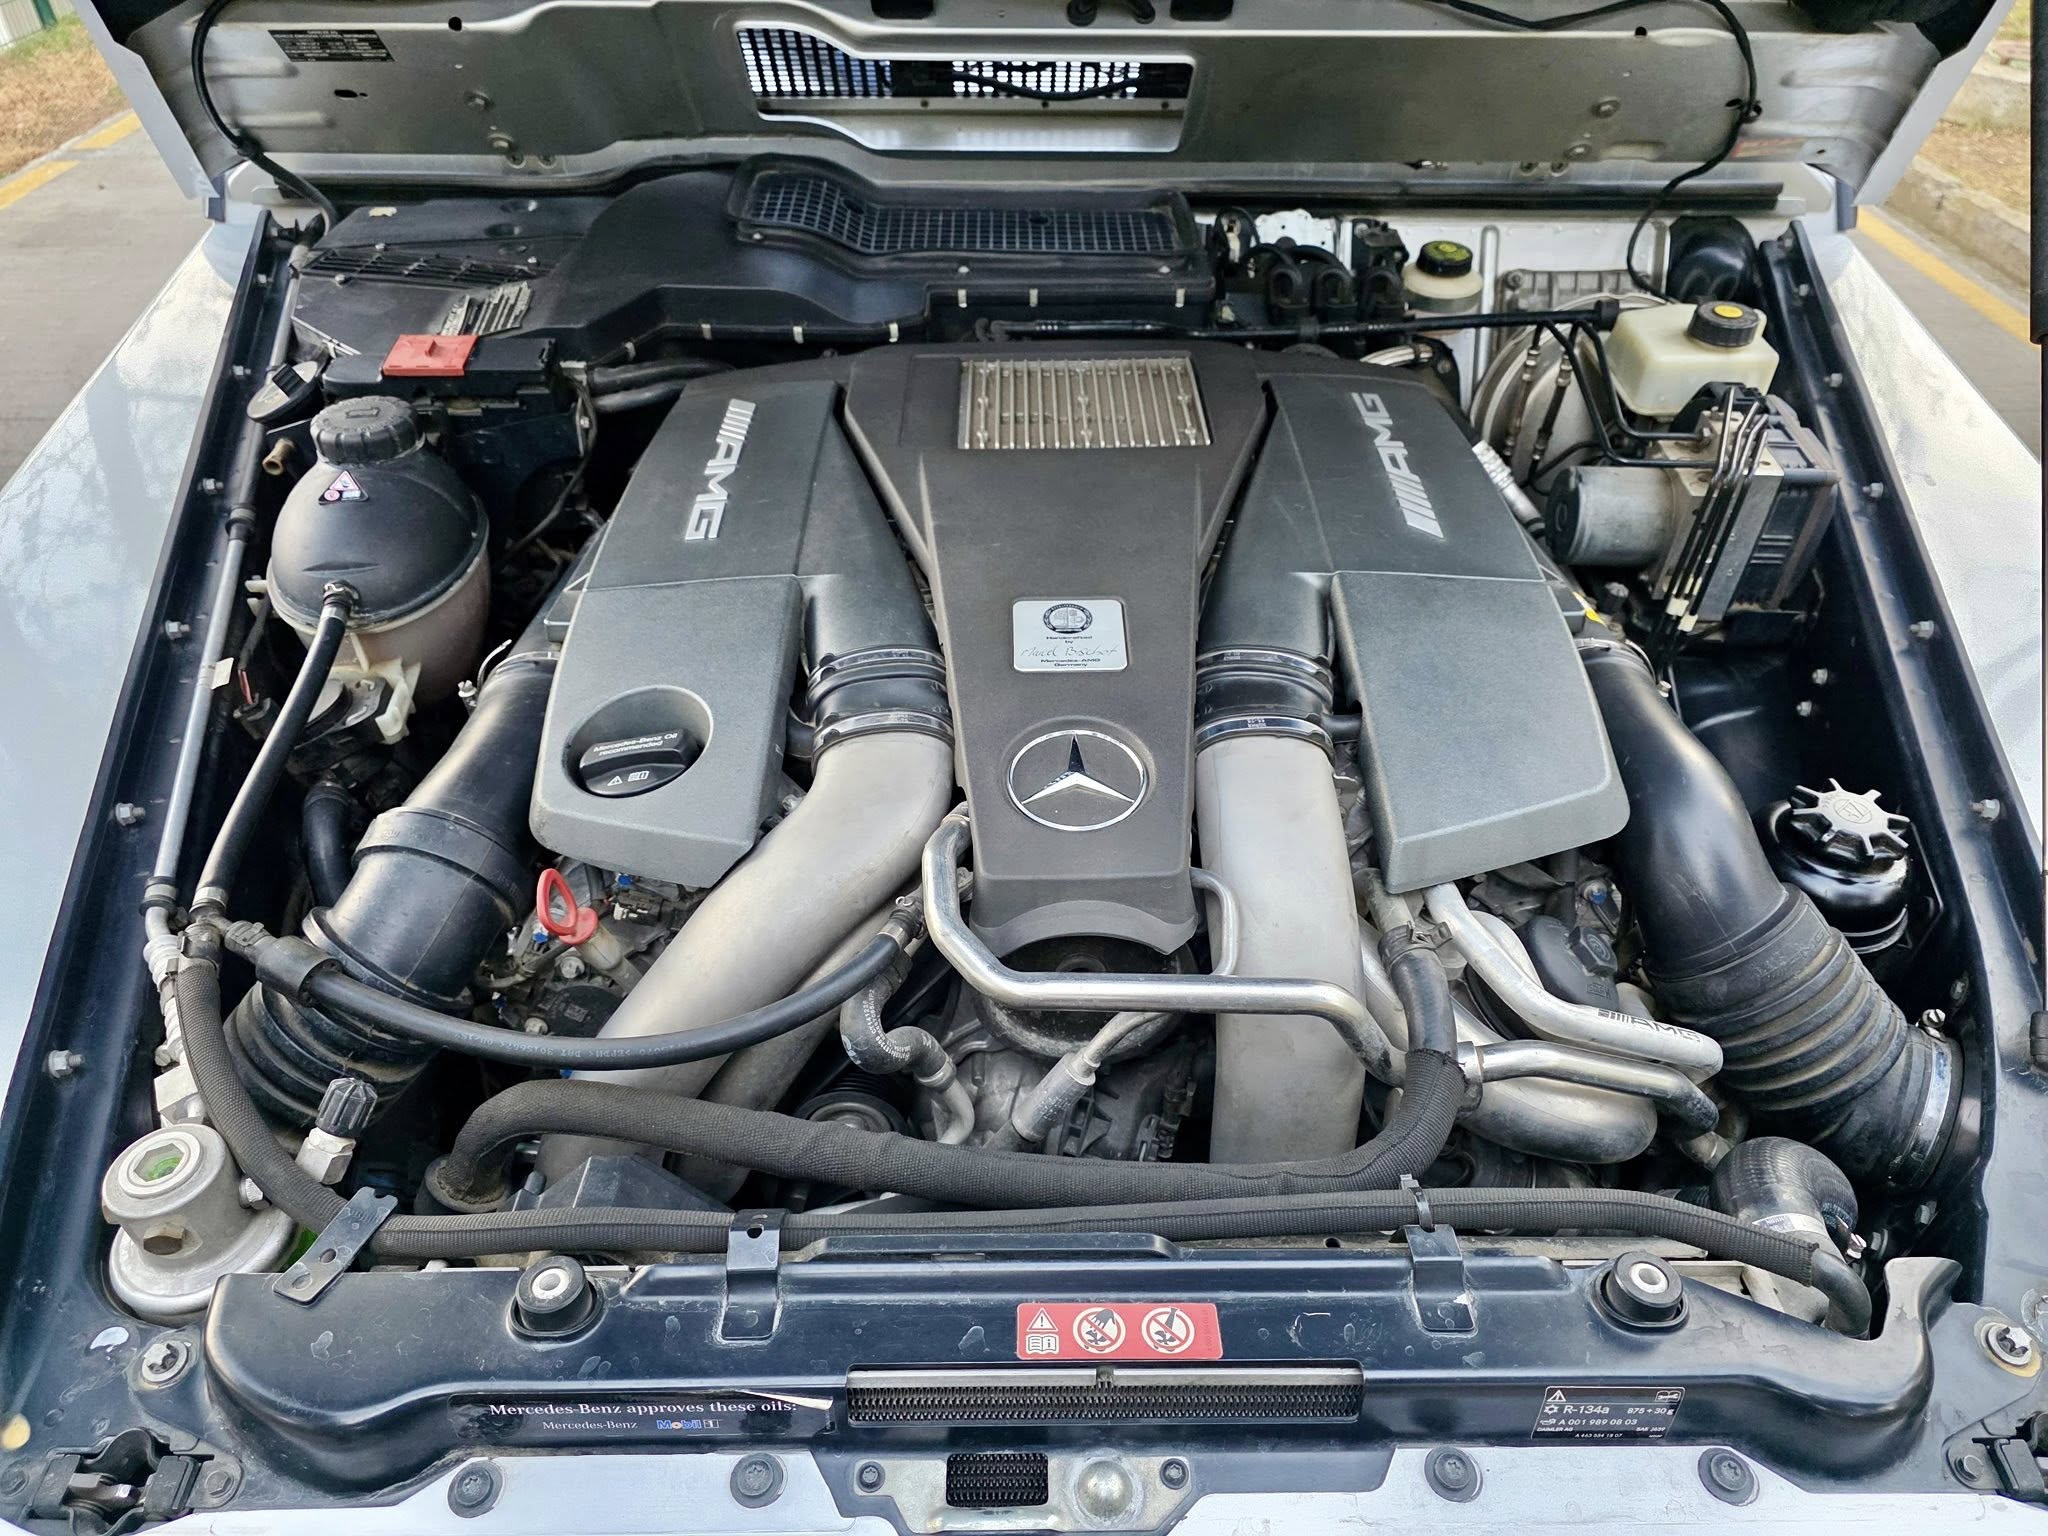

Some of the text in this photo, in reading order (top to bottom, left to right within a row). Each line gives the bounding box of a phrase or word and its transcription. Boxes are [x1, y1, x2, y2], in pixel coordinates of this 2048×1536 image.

[1351, 392, 1423, 487] AMG
[685, 433, 744, 540] AMG
[593, 732, 678, 752] Mercedes-Benz Oil
[599, 740, 663, 756] recommended
[1630, 1016, 1701, 1043] AMG
[489, 1400, 797, 1416] Mercedes-Benz approves these oils:
[1563, 1405, 1610, 1414] R-134a
[542, 1420, 638, 1430] Mercedes-Benz
[656, 1419, 702, 1430] Mobil
